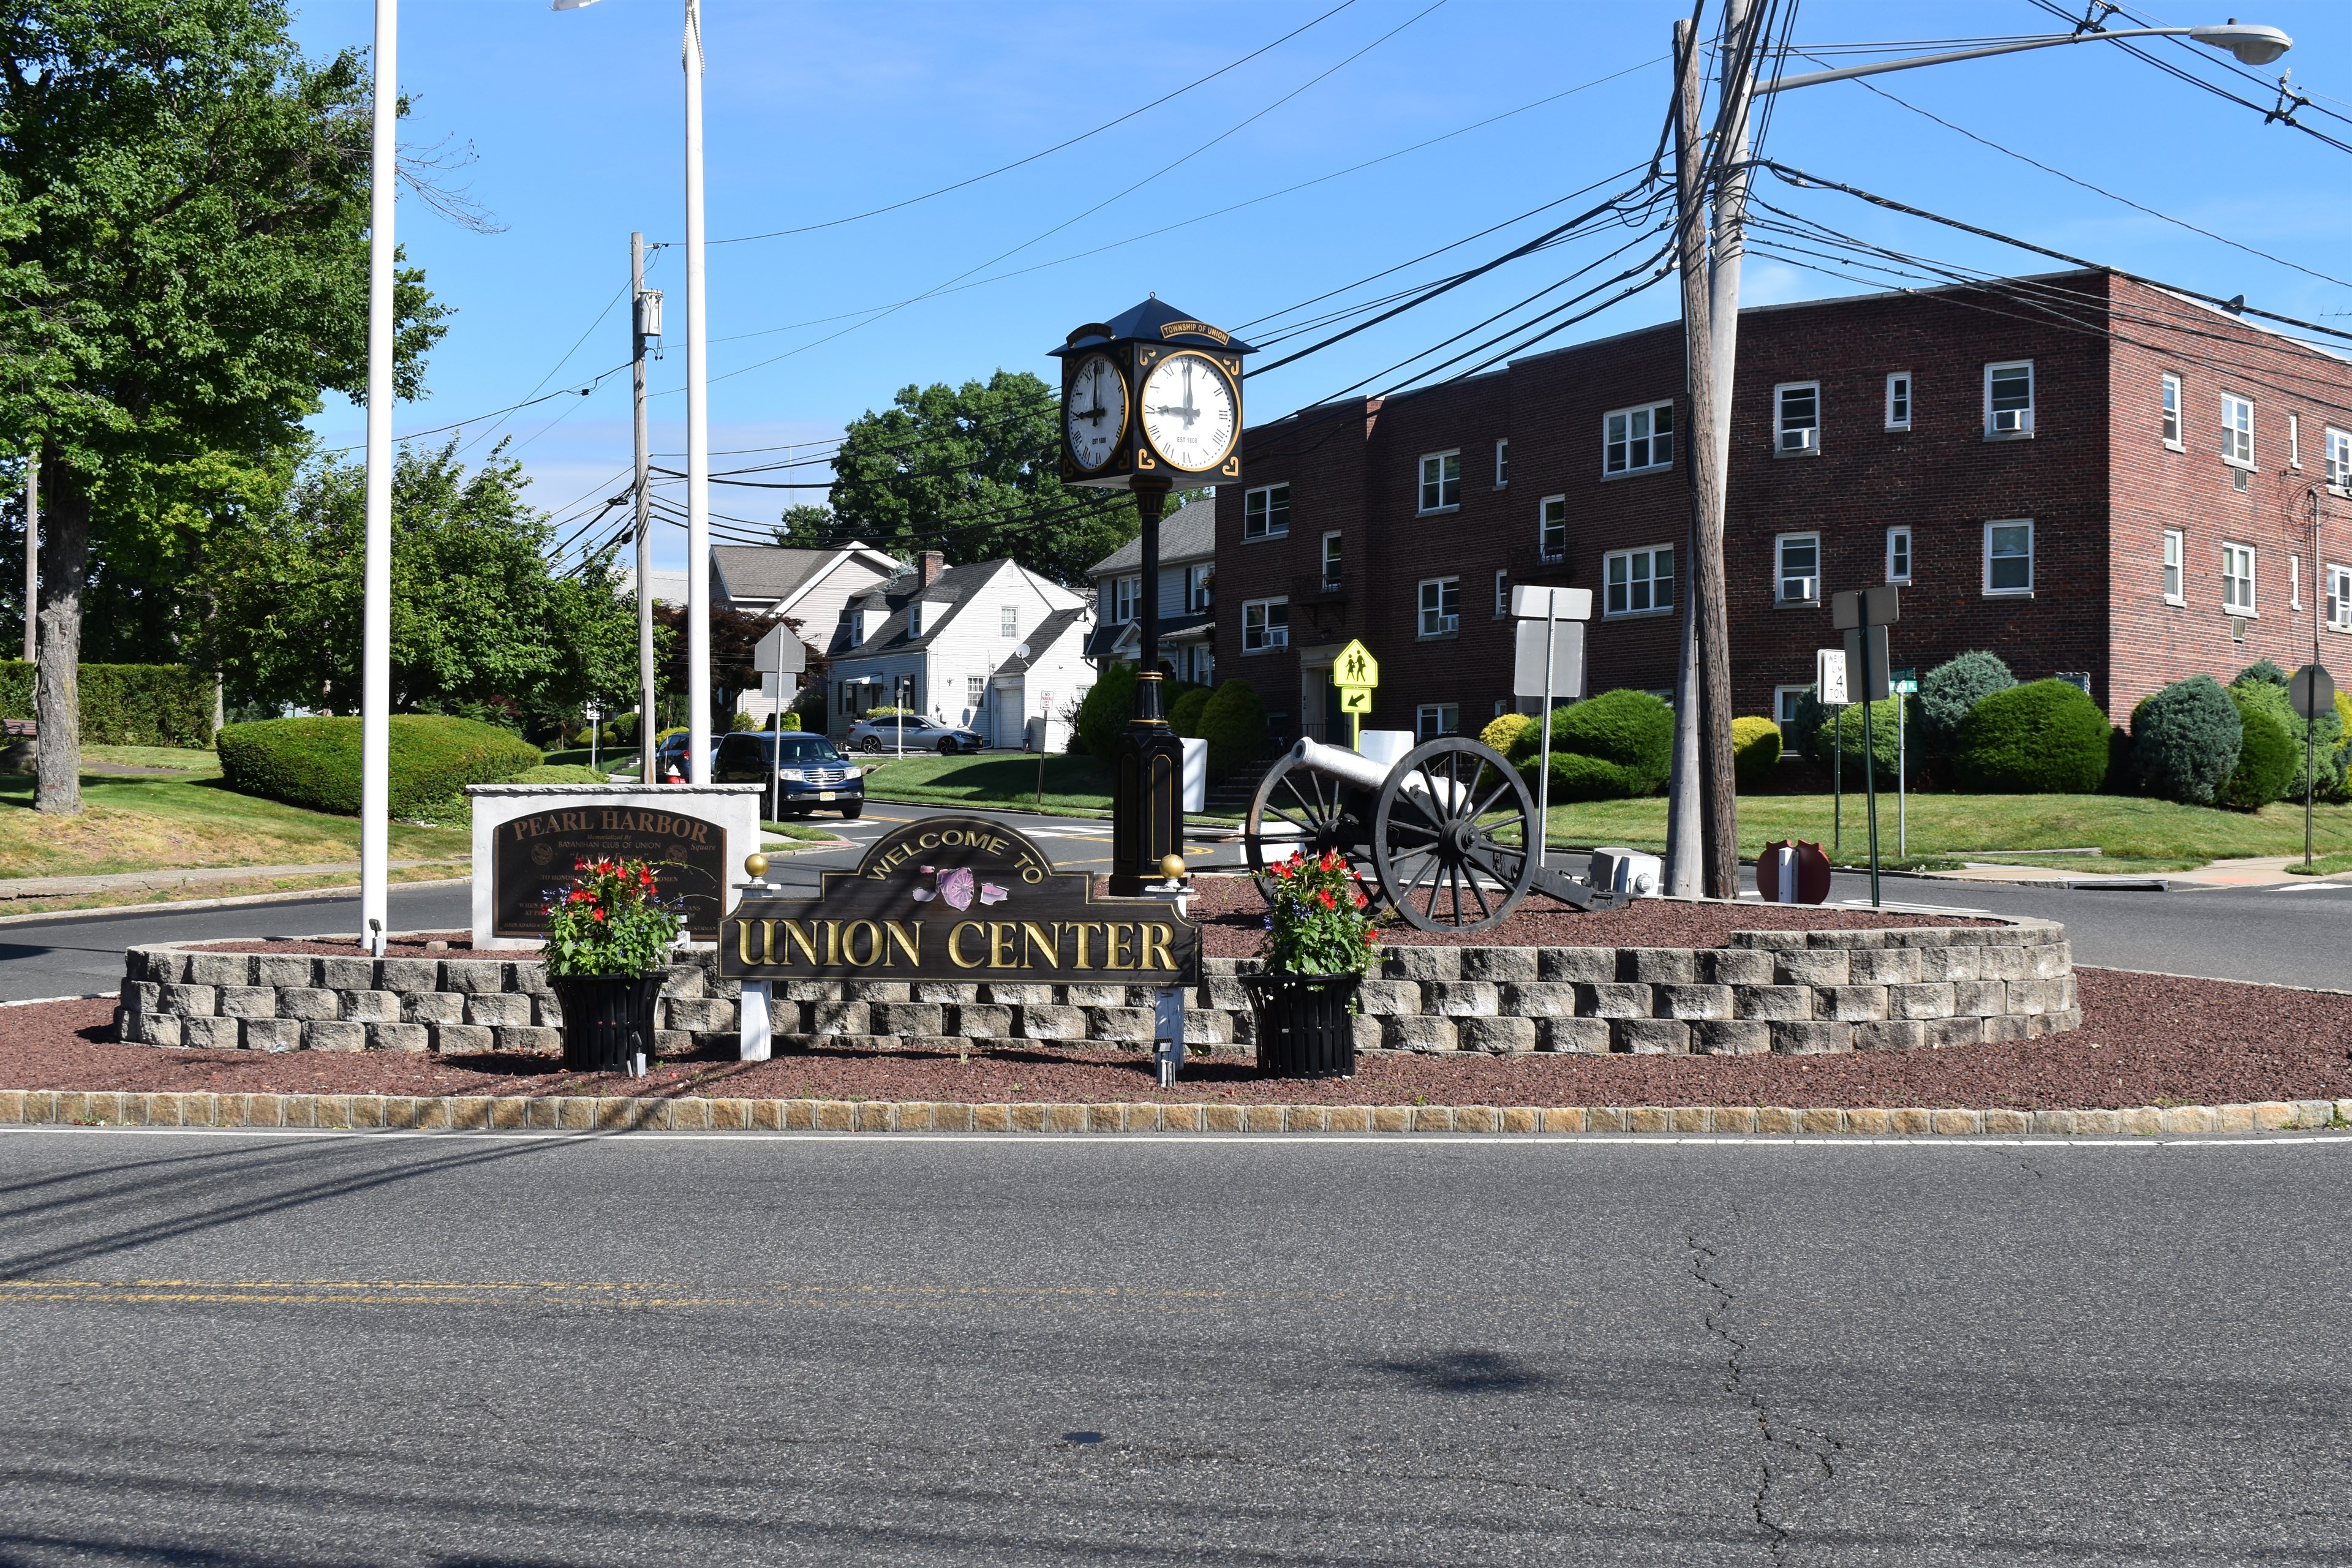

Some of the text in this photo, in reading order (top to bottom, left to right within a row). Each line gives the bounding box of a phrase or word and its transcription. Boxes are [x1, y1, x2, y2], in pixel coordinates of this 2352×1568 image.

[1164, 323, 1196, 334] TOWNSHIP
[1207, 327, 1227, 342] UNION
[1829, 688, 1845, 698] TON
[1836, 675, 1843, 687] 4
[512, 811, 708, 843] PEARL HARBOR
[866, 829, 1044, 884] WELCOME TO
[736, 918, 1180, 971] UNION CENTER
